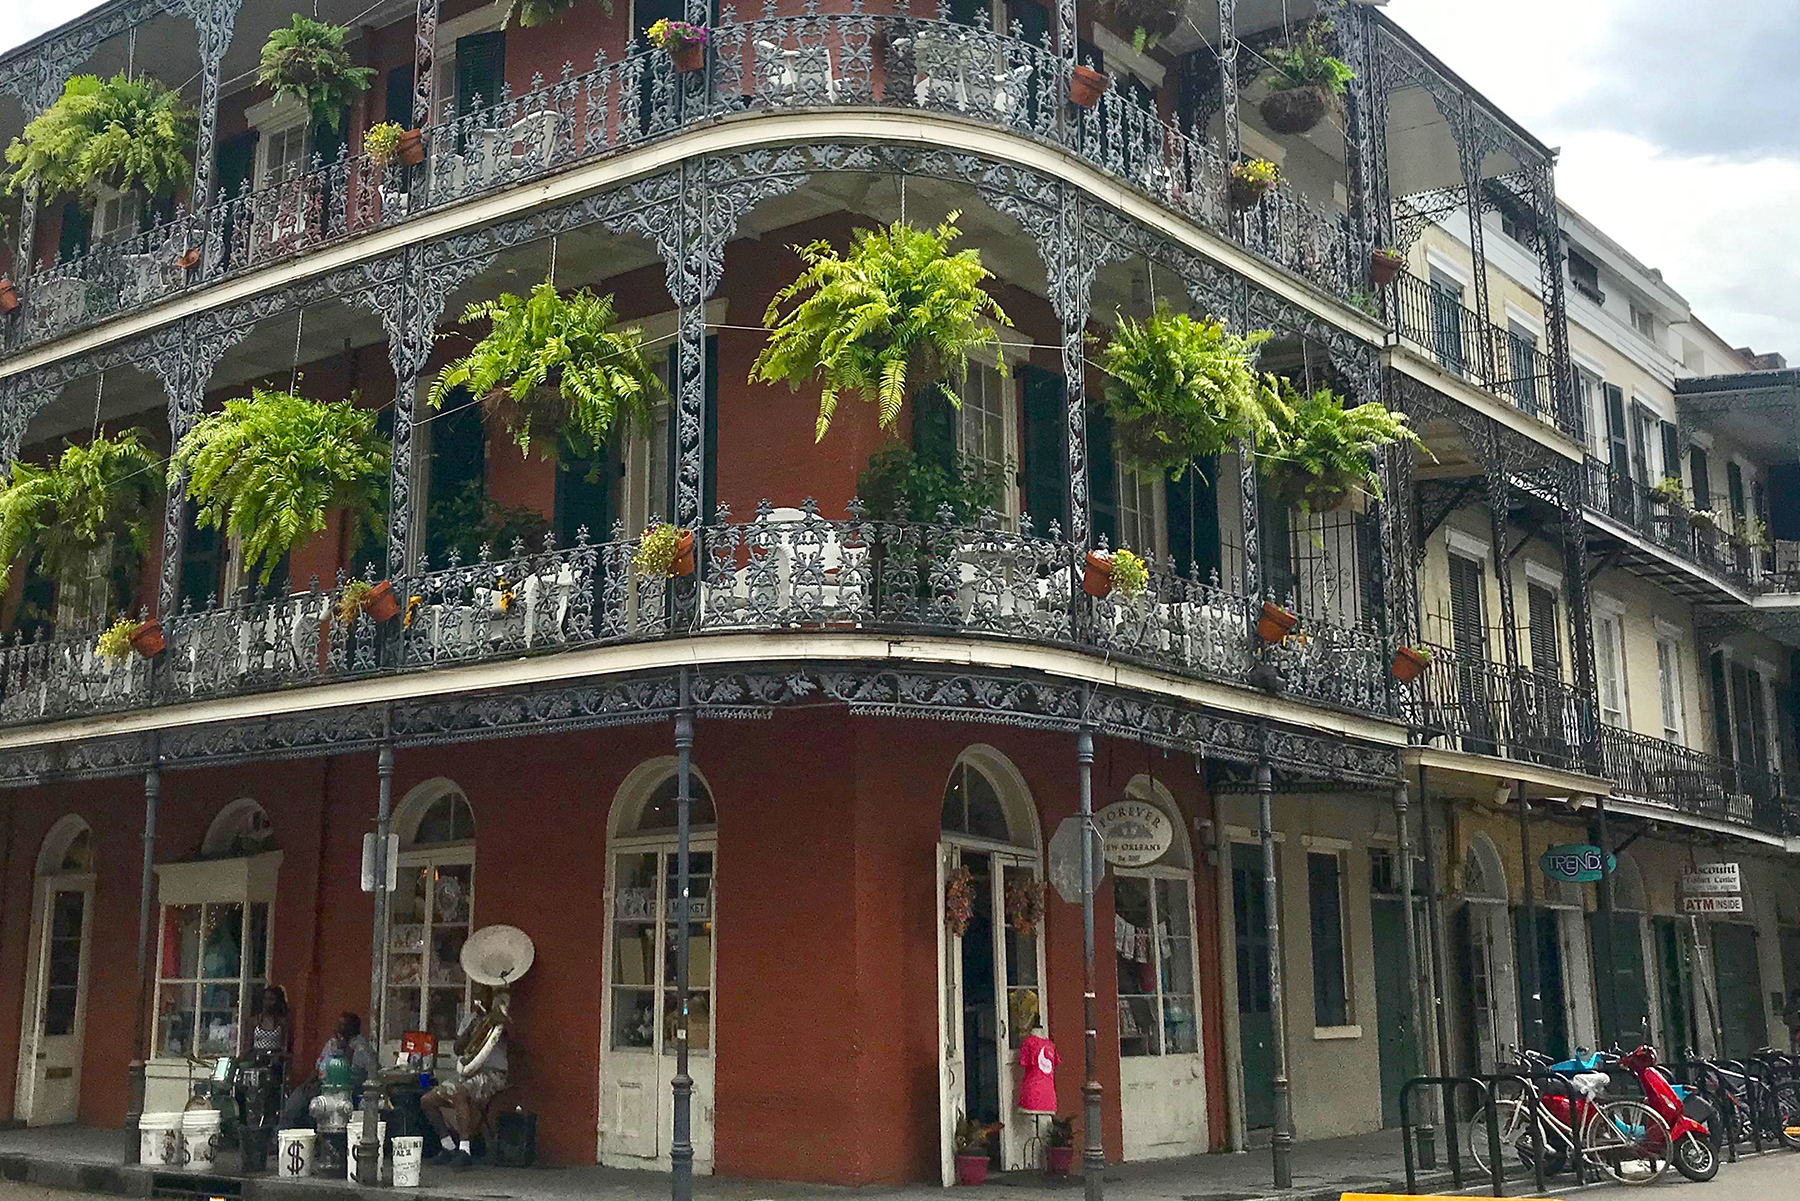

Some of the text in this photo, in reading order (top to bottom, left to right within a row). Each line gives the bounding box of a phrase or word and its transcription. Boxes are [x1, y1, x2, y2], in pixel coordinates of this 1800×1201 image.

[1099, 807, 1160, 828] FOREVER
[1121, 843, 1160, 851] ORLEANS
[1684, 865, 1736, 874] Discount
[1686, 899, 1740, 910] ATM INSIDE
